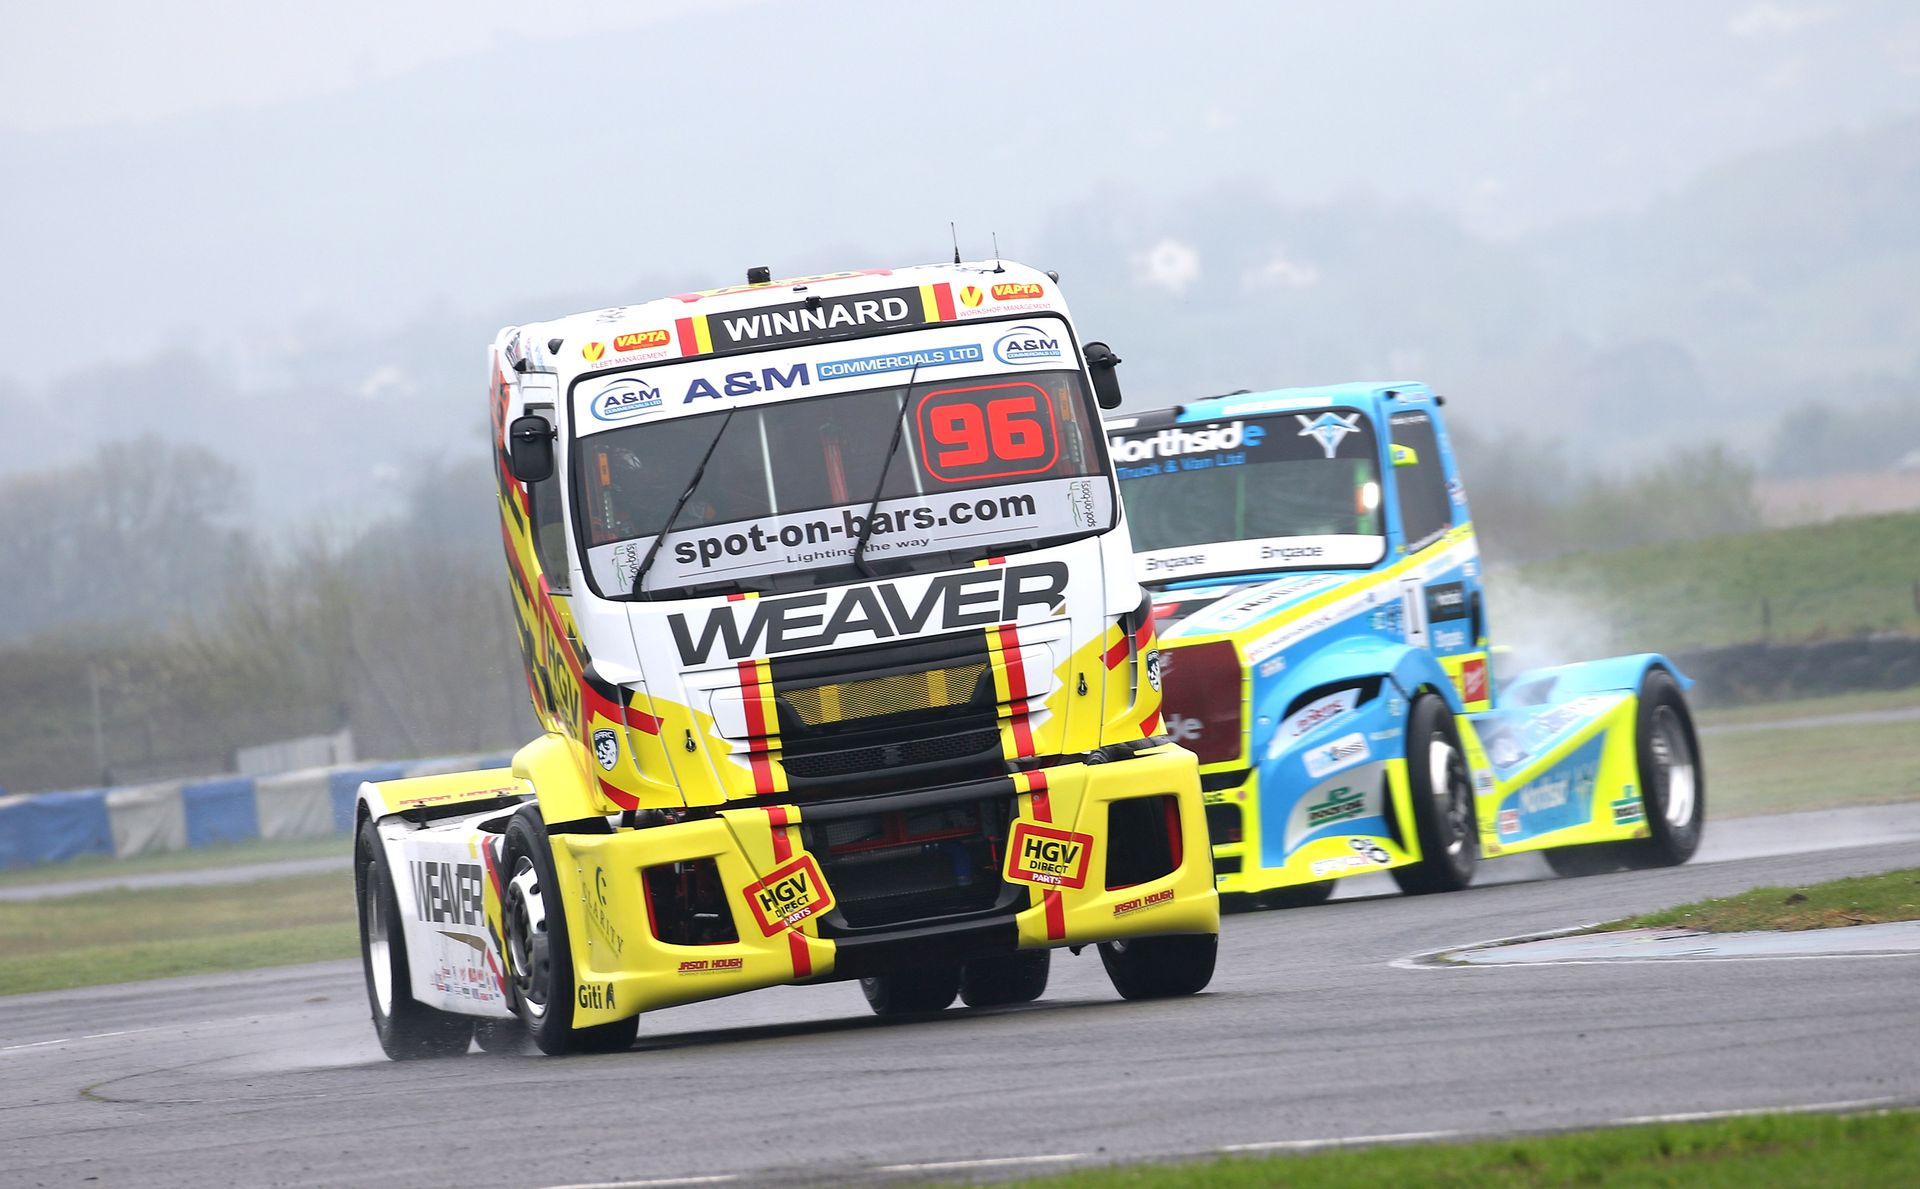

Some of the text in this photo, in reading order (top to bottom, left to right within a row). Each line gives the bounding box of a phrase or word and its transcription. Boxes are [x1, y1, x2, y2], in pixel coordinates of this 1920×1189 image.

[993, 284, 1040, 296] VAPTA
[723, 297, 909, 342] WINNARD
[616, 330, 667, 347] VAPTA
[1006, 339, 1058, 352] A&M
[821, 347, 979, 378] COMMERCIALS LTD
[683, 363, 810, 403] A&M
[604, 387, 660, 408] A&M
[930, 396, 1046, 468] 96
[675, 493, 1037, 568] spot-on-bars.com
[787, 537, 931, 563] Lighting the way
[667, 561, 1069, 667] WEAVER
[1024, 838, 1079, 864] HGV
[1029, 860, 1068, 874] DIRECT
[1032, 873, 1062, 885] PARTS
[409, 860, 485, 927] WEAVER
[760, 872, 808, 912] HGV
[1113, 898, 1141, 914] JASON
[1145, 889, 1175, 904] HOUGH
[775, 894, 809, 918] DIRECT
[678, 957, 743, 971] JASON HOUGH
[578, 984, 602, 1009] Giti
